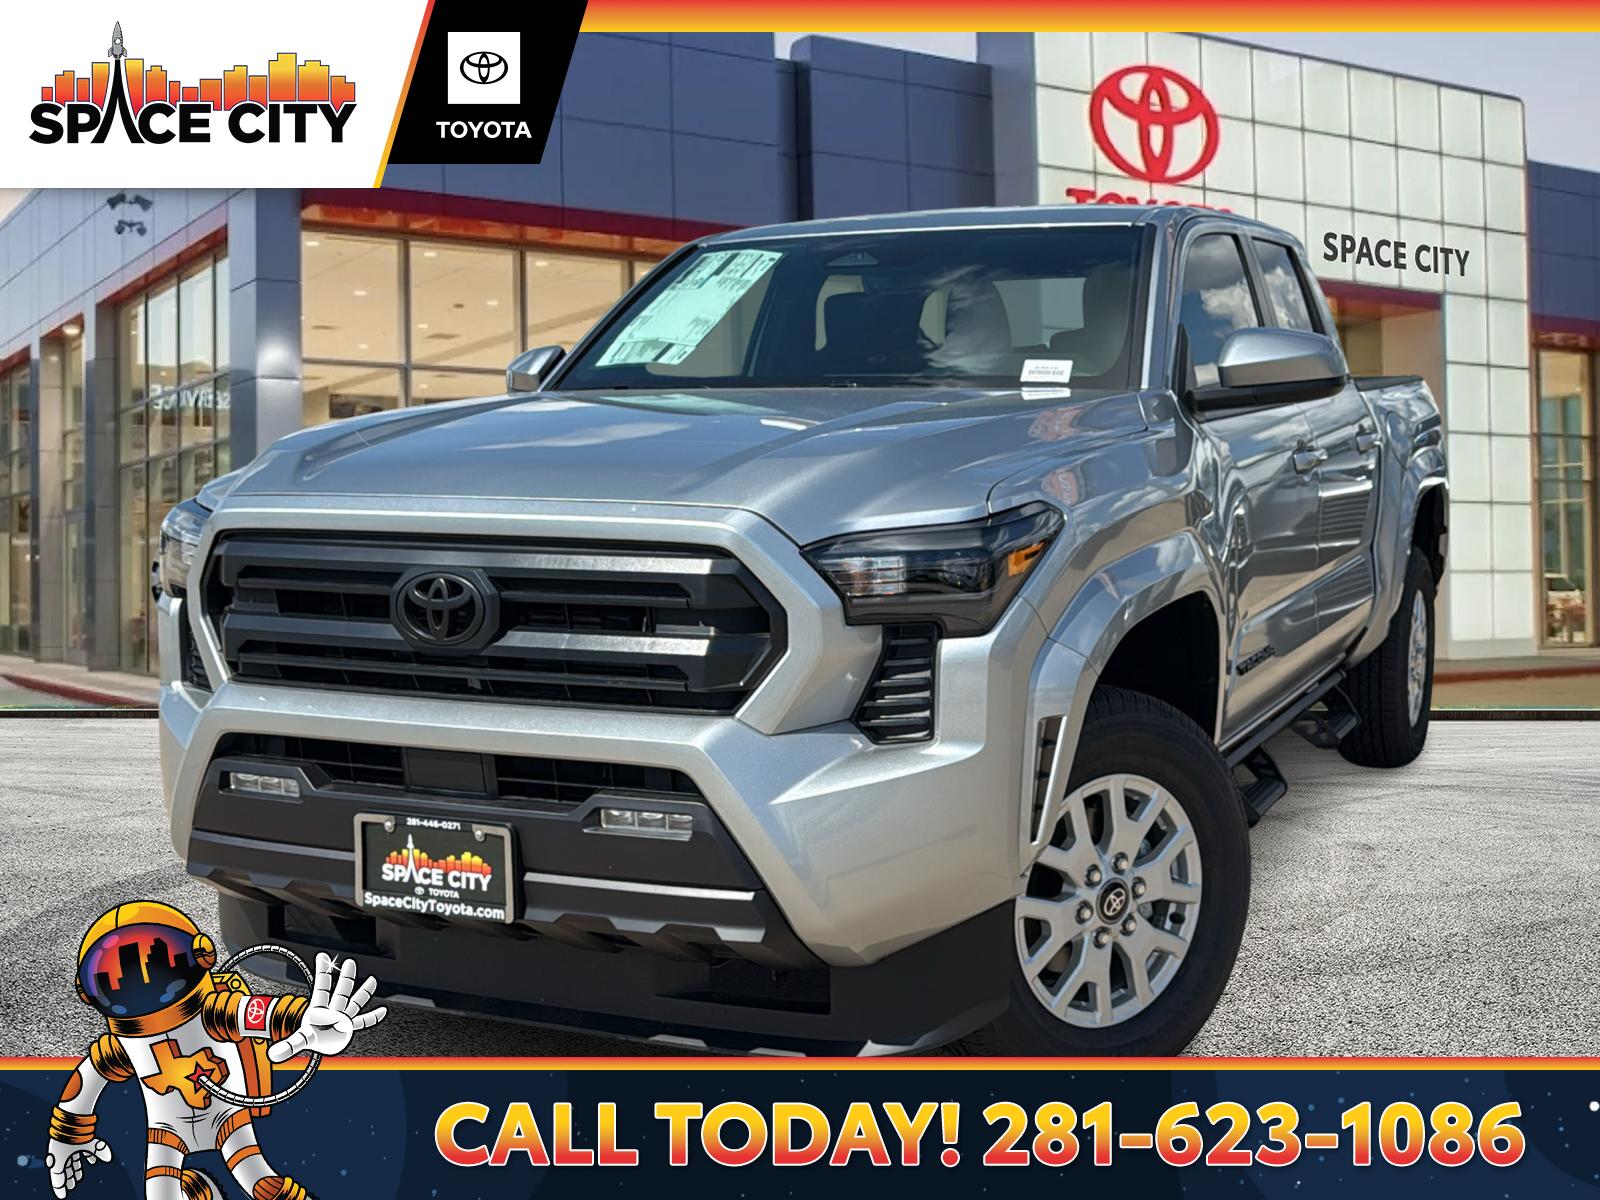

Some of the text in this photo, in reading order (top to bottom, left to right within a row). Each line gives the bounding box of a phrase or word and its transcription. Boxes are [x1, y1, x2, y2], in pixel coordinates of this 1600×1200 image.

[1323, 232, 1470, 276] SPACE CITY
[382, 847, 492, 892] SPACE CITY
[364, 891, 505, 920] SpaceCityToyota.com
[428, 887, 460, 899] TOYOTA
